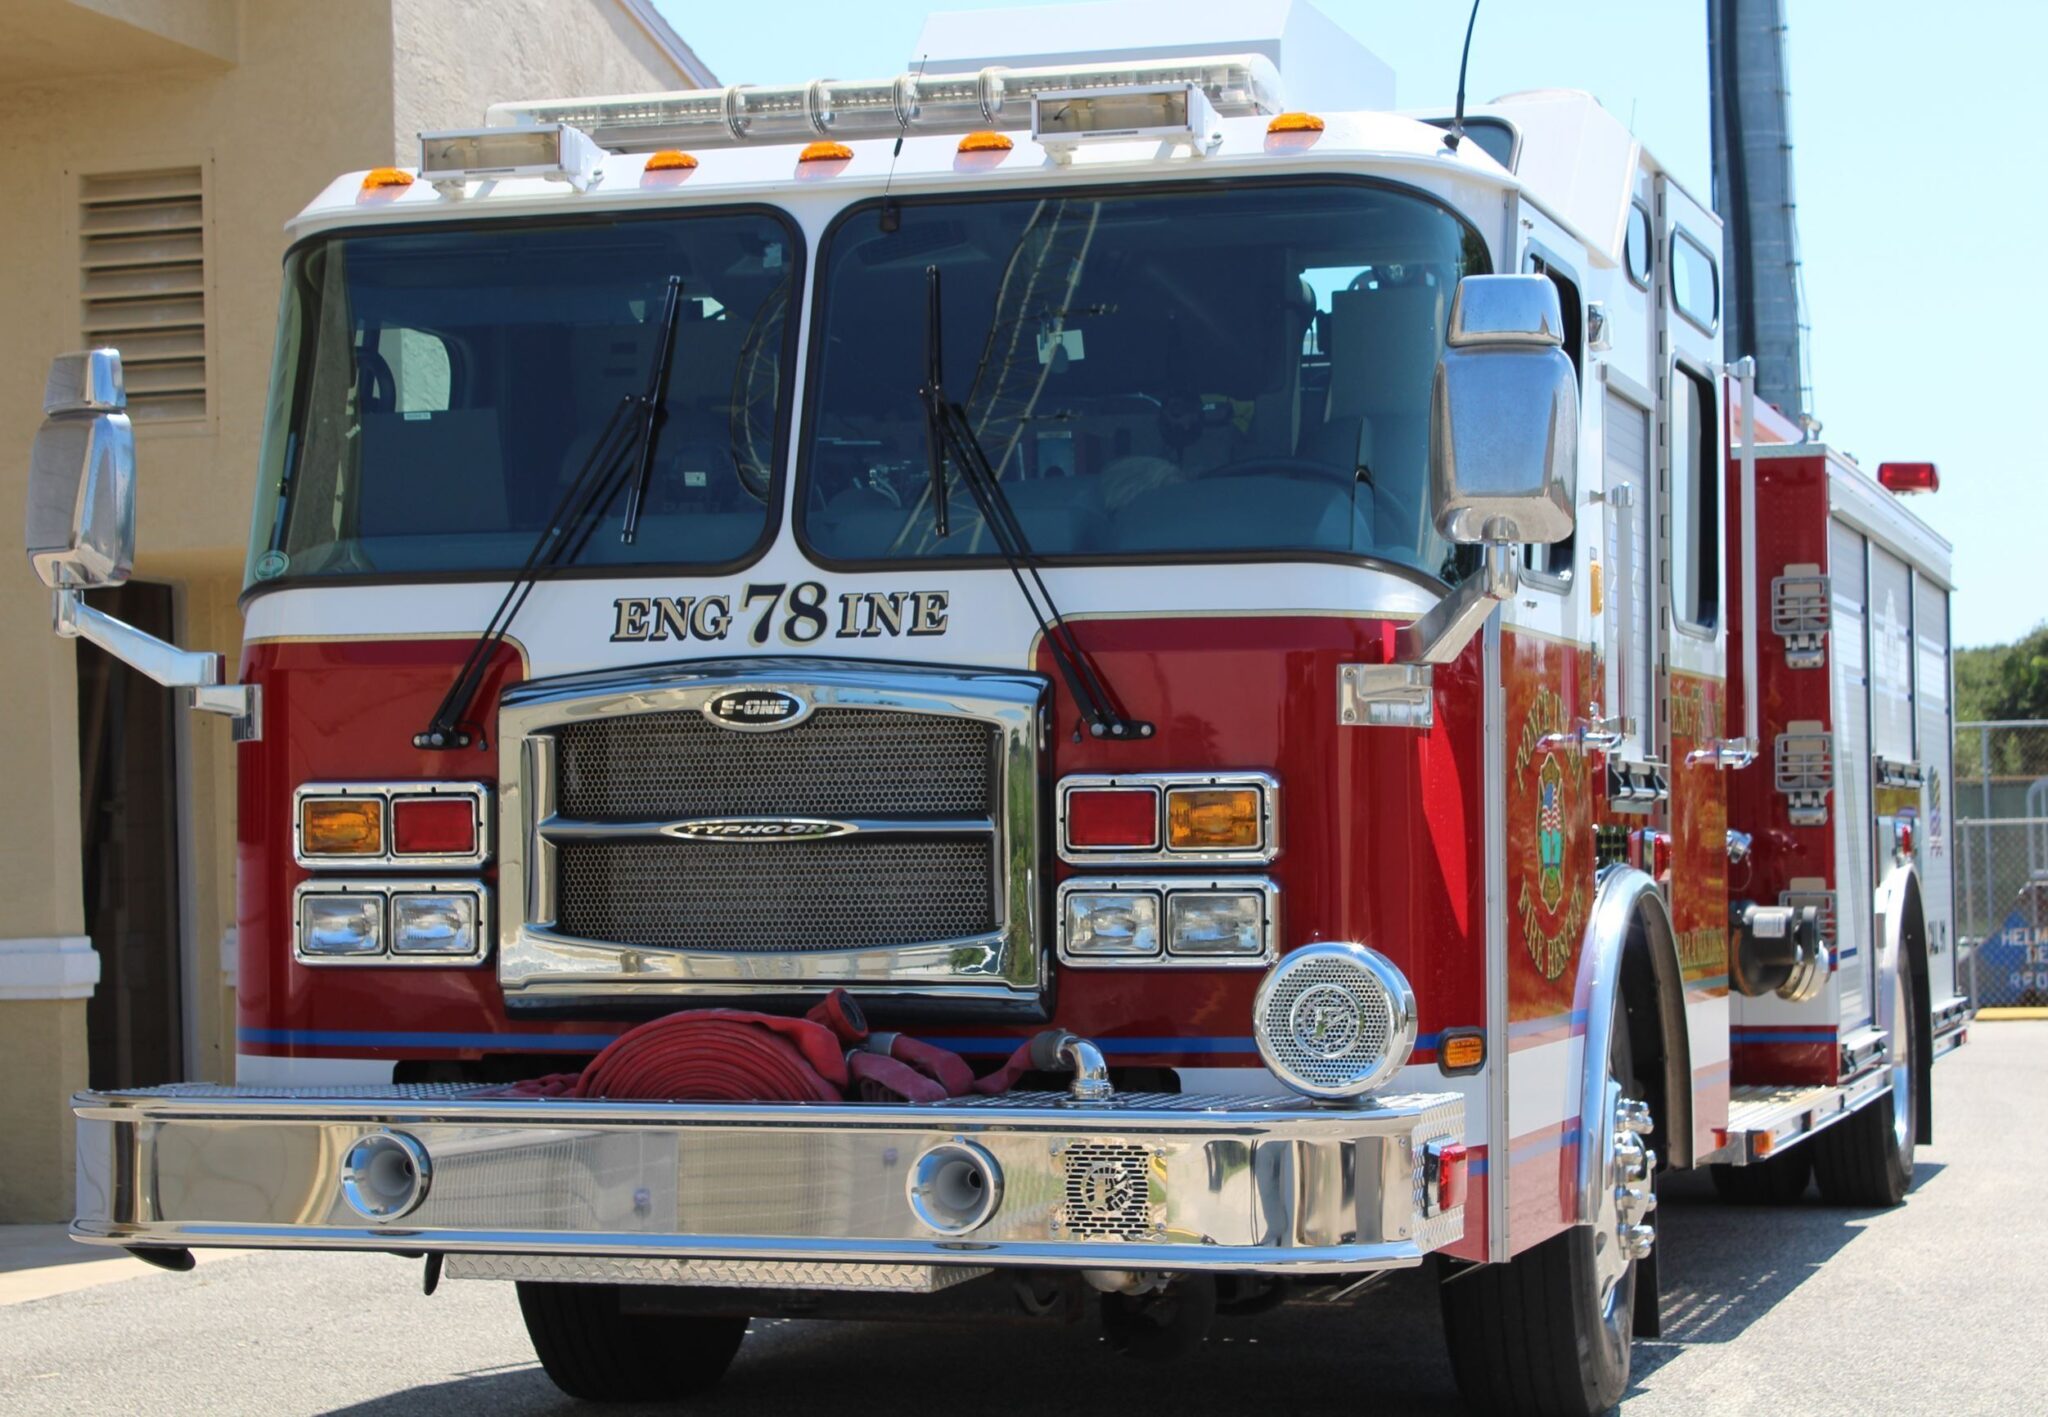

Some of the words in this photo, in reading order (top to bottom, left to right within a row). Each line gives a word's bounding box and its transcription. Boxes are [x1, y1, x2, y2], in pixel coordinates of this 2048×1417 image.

[609, 595, 732, 643] ENG
[738, 581, 828, 647] 78
[836, 590, 950, 639] INE
[720, 699, 790, 715] E-ONE
[687, 824, 829, 835] TYPHOON
[1517, 873, 1545, 974] FIRE
